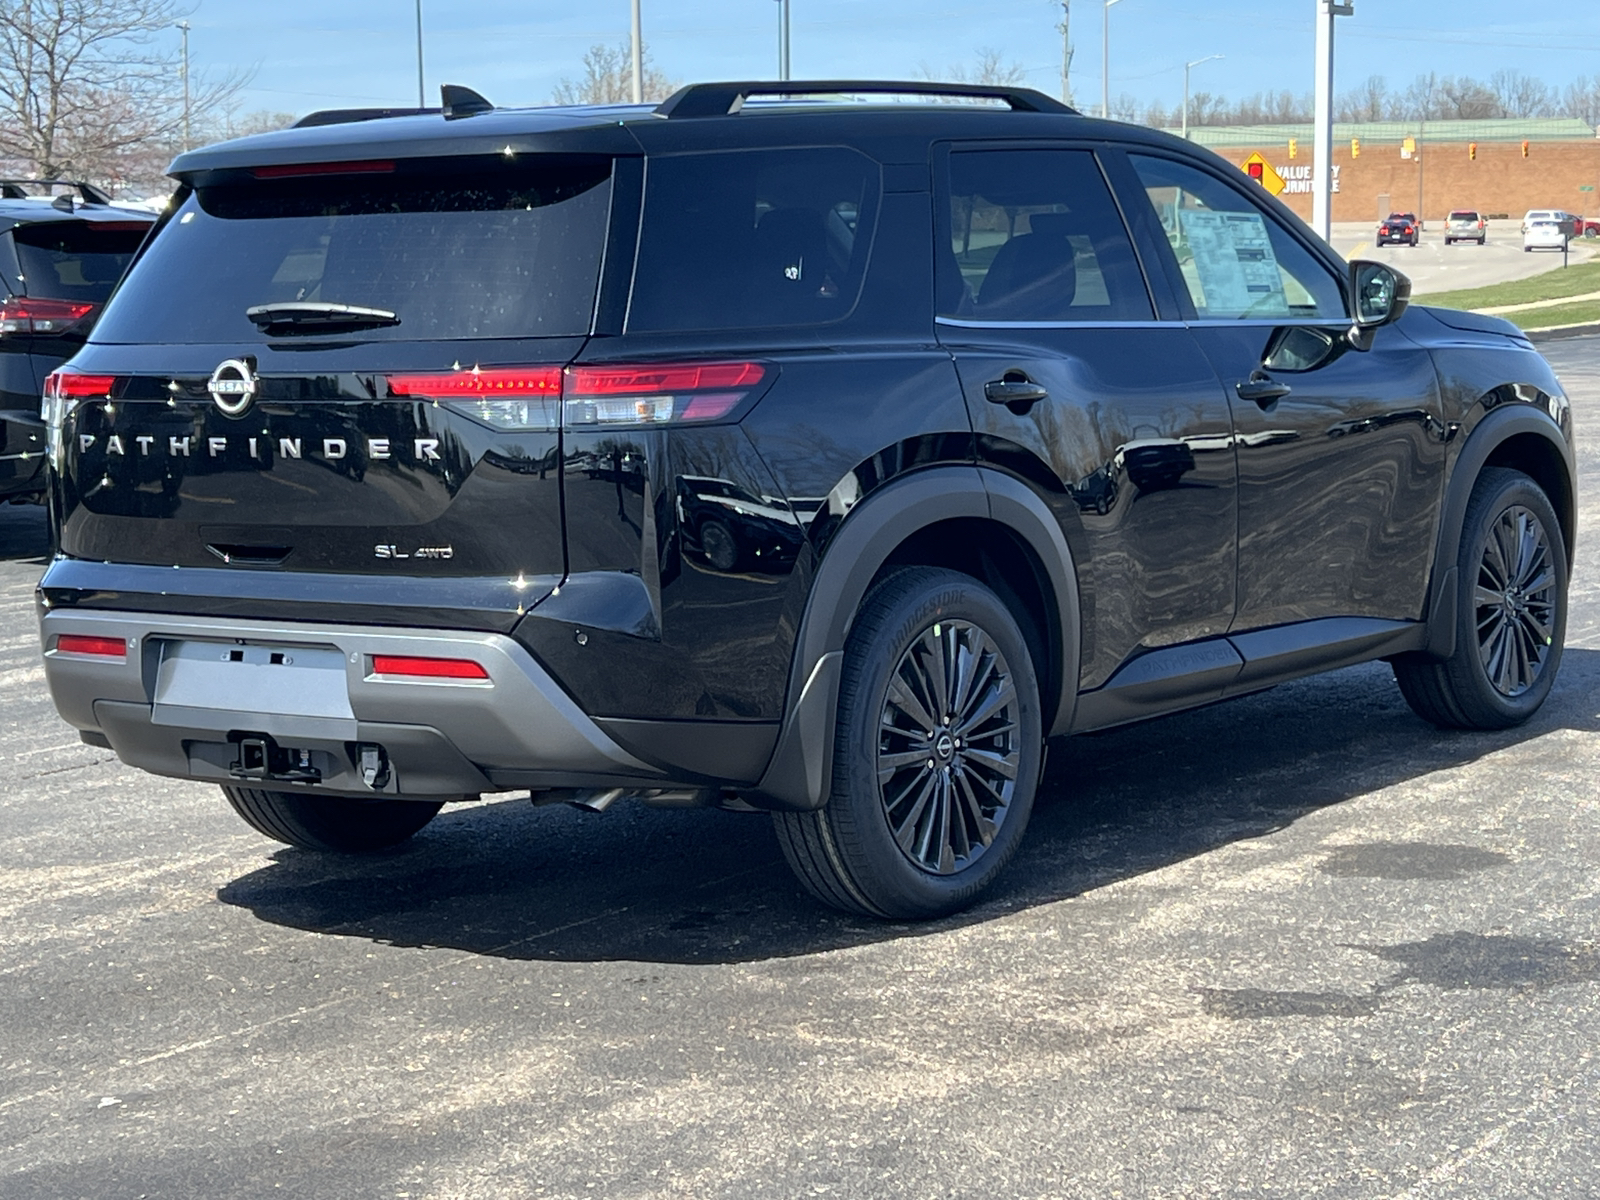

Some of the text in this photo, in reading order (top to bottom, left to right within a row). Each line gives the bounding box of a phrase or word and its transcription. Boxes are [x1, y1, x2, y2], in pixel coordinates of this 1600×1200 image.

[1275, 165, 1311, 179] VALUE
[207, 380, 255, 393] NISSAN
[79, 433, 441, 460] PATHFINDER
[374, 544, 453, 558] SL 4WD
[1140, 646, 1238, 675] PATHFINDER
